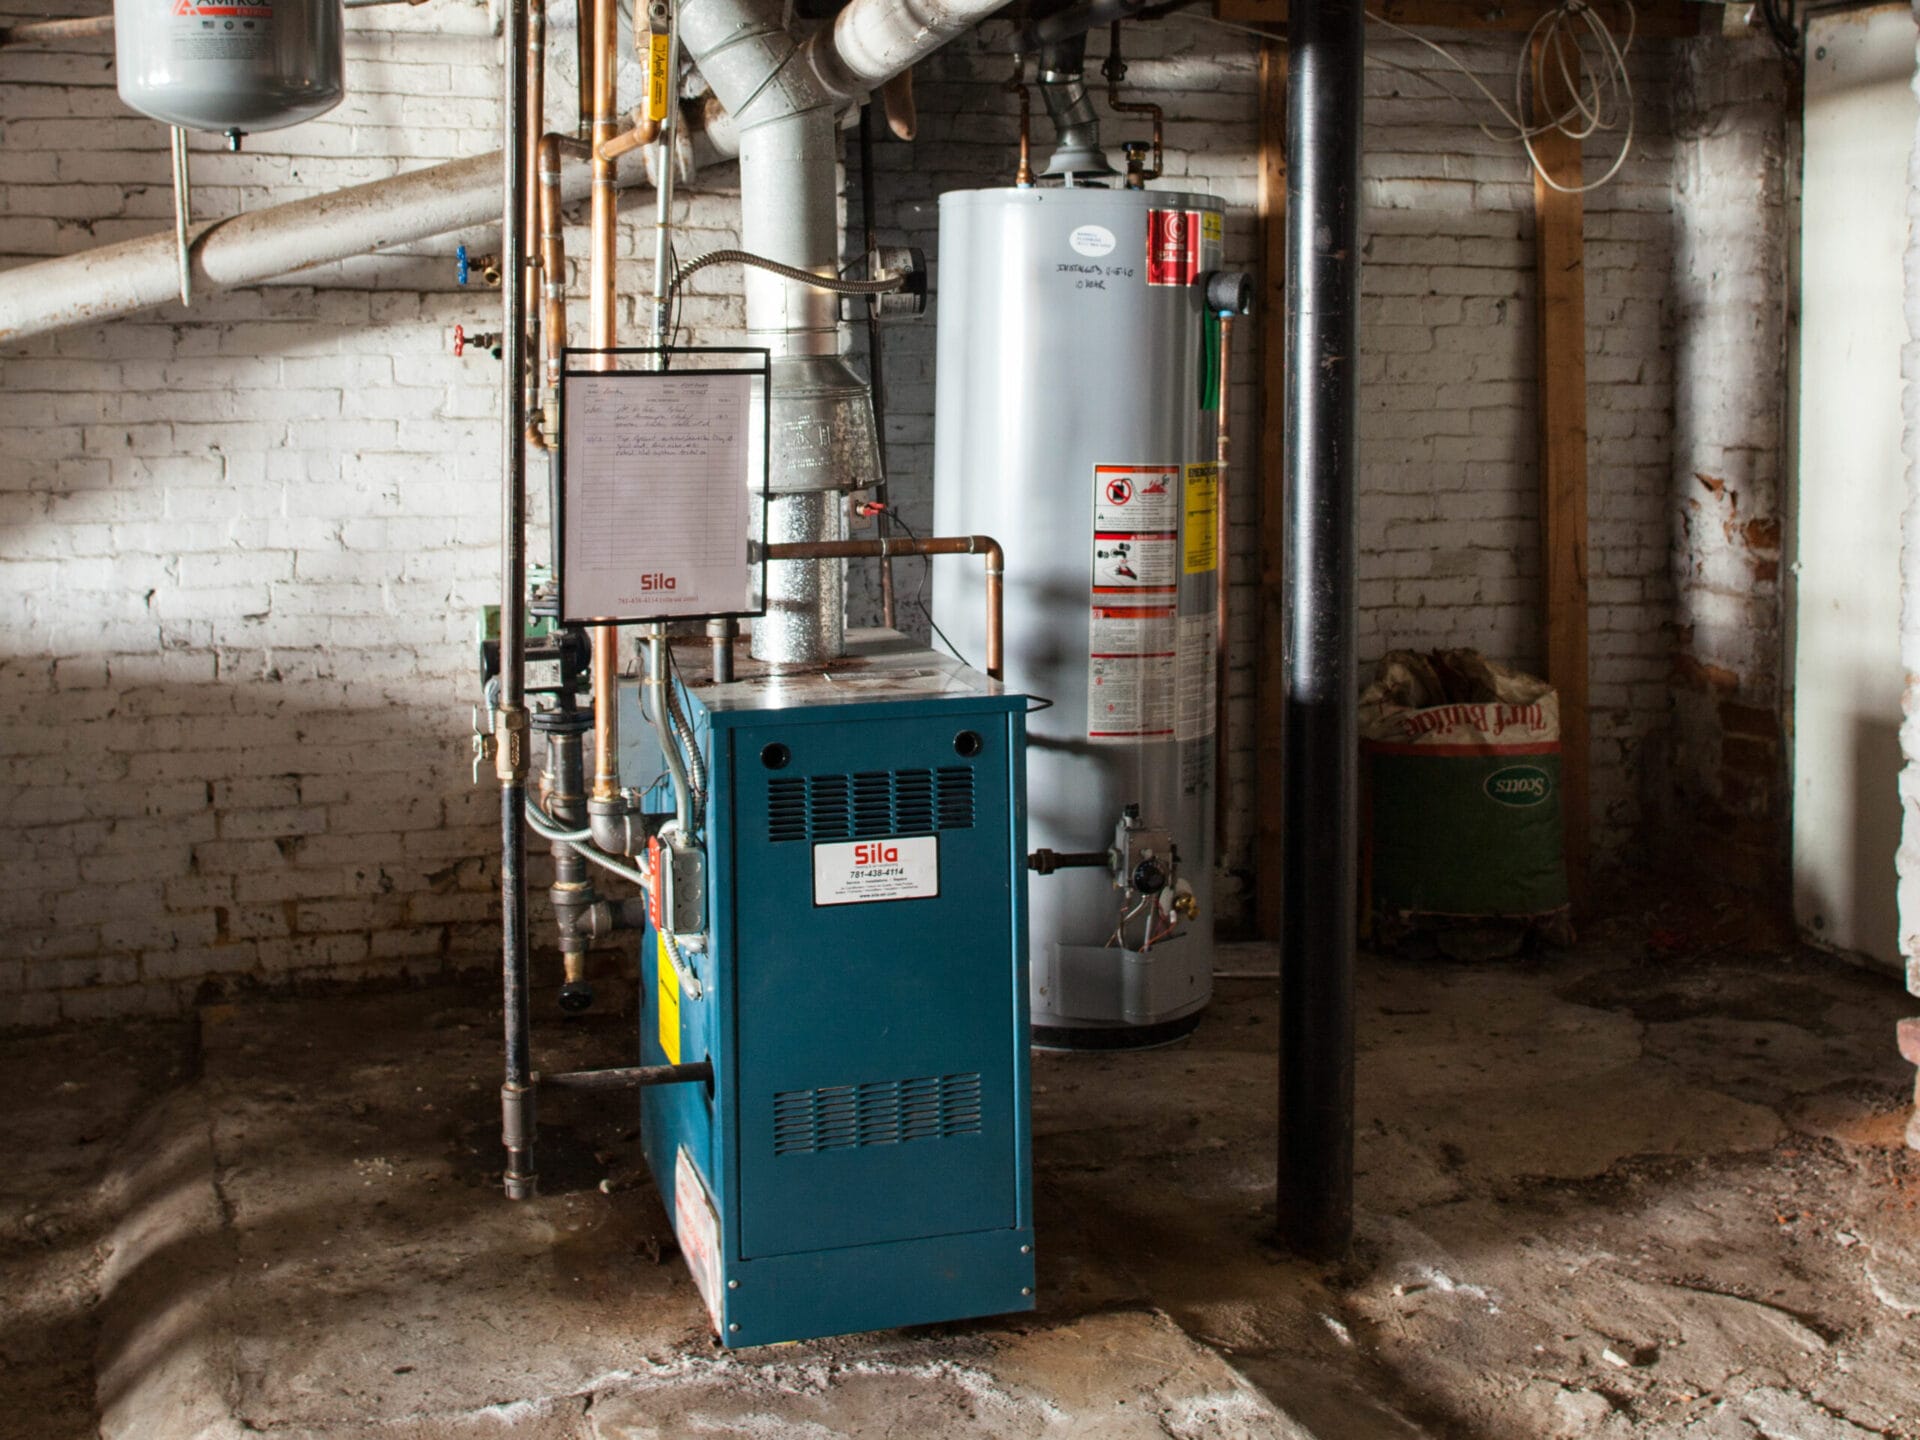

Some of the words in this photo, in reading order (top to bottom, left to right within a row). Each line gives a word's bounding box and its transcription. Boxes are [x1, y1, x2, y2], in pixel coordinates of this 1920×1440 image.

[640, 573, 676, 591] Sila
[1493, 704, 1547, 737] Turf
[1495, 778, 1545, 796] Scotts
[854, 842, 898, 865] Sila
[850, 868, 904, 879] 781-438-4114
